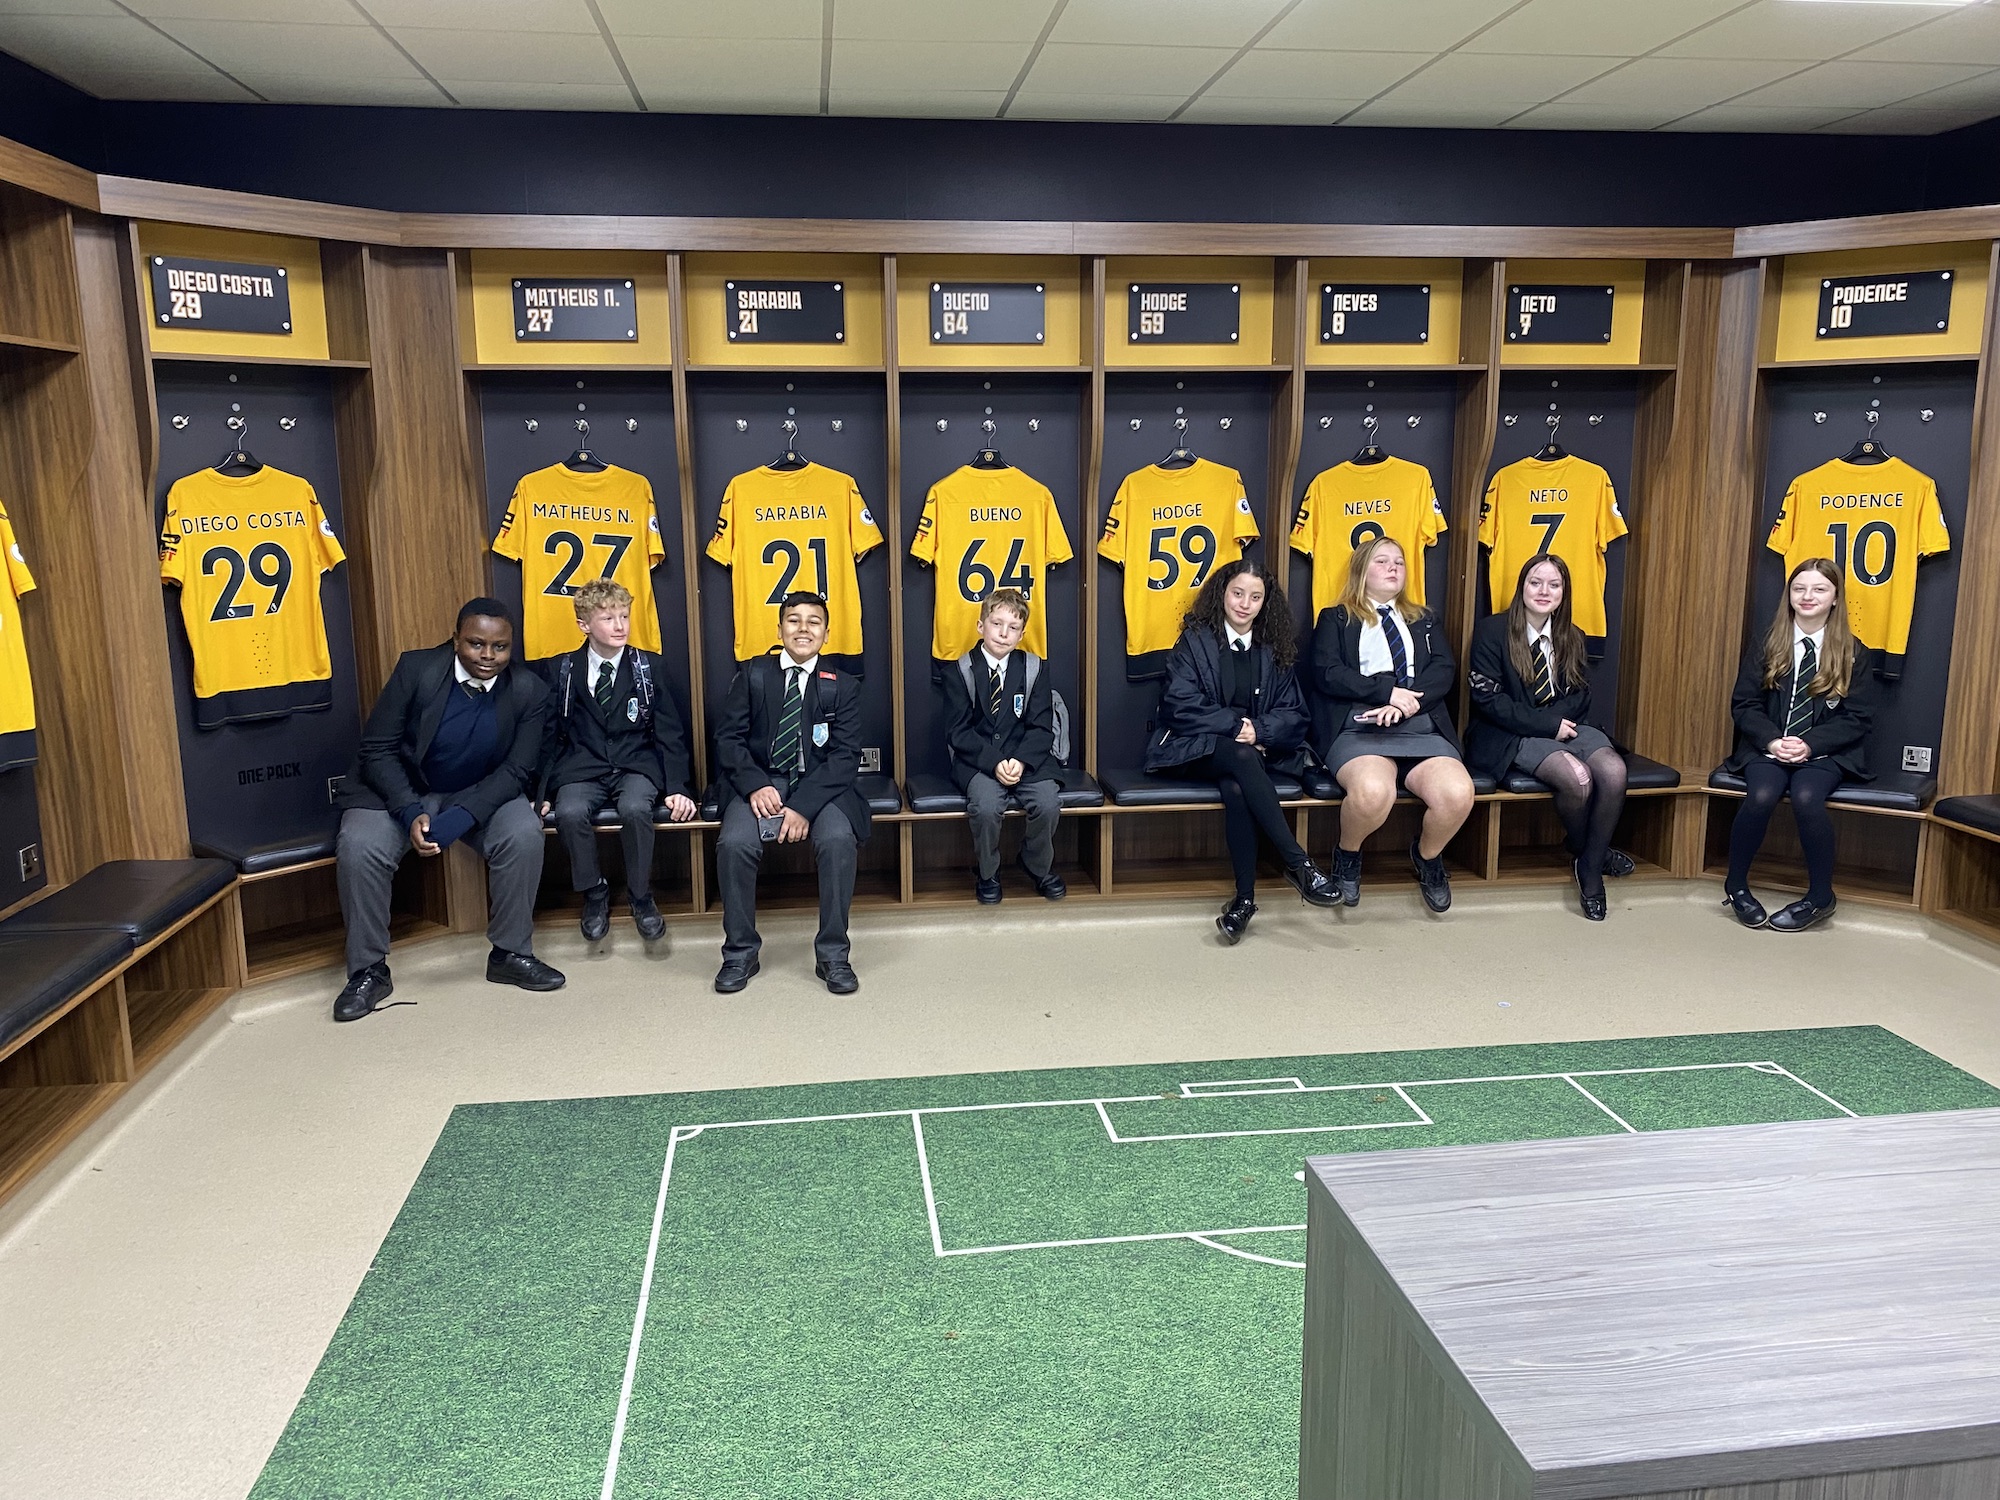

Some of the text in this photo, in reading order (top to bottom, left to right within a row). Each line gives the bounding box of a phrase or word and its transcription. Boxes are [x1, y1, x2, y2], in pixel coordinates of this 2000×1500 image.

[167, 269, 274, 298] DIEGO COSTA
[1832, 282, 1908, 305] PODENCE
[170, 291, 202, 319] 29
[524, 288, 598, 307] MATHEUS
[738, 290, 802, 310] SARABIA
[943, 292, 989, 311] BUENO
[1141, 293, 1187, 311] HODGE
[1333, 294, 1377, 312] NEVES
[1520, 295, 1556, 313] NETO
[527, 308, 553, 332] 27
[739, 310, 758, 333] 21
[943, 312, 968, 335] 64
[1141, 312, 1164, 335] 59
[1332, 312, 1345, 335] 8
[1520, 313, 1532, 335] 7
[1830, 305, 1852, 329] 10
[1344, 499, 1392, 516] NEVES
[1529, 489, 1568, 503] NETO
[1820, 493, 1904, 510] PODENCE
[181, 511, 306, 535] DIEGO COSTA
[533, 503, 634, 524] MATHEUS N.
[755, 505, 828, 522] SARABIA
[970, 507, 1022, 523] BUENO
[1152, 503, 1203, 521] HODGE
[1529, 513, 1566, 554] 7
[542, 530, 634, 597] 27
[1147, 524, 1217, 591] 59
[1826, 520, 1897, 587] 10
[201, 541, 293, 622] 29
[761, 537, 829, 605] 21
[958, 538, 1035, 603] 64
[238, 762, 302, 786] ONE PACK
